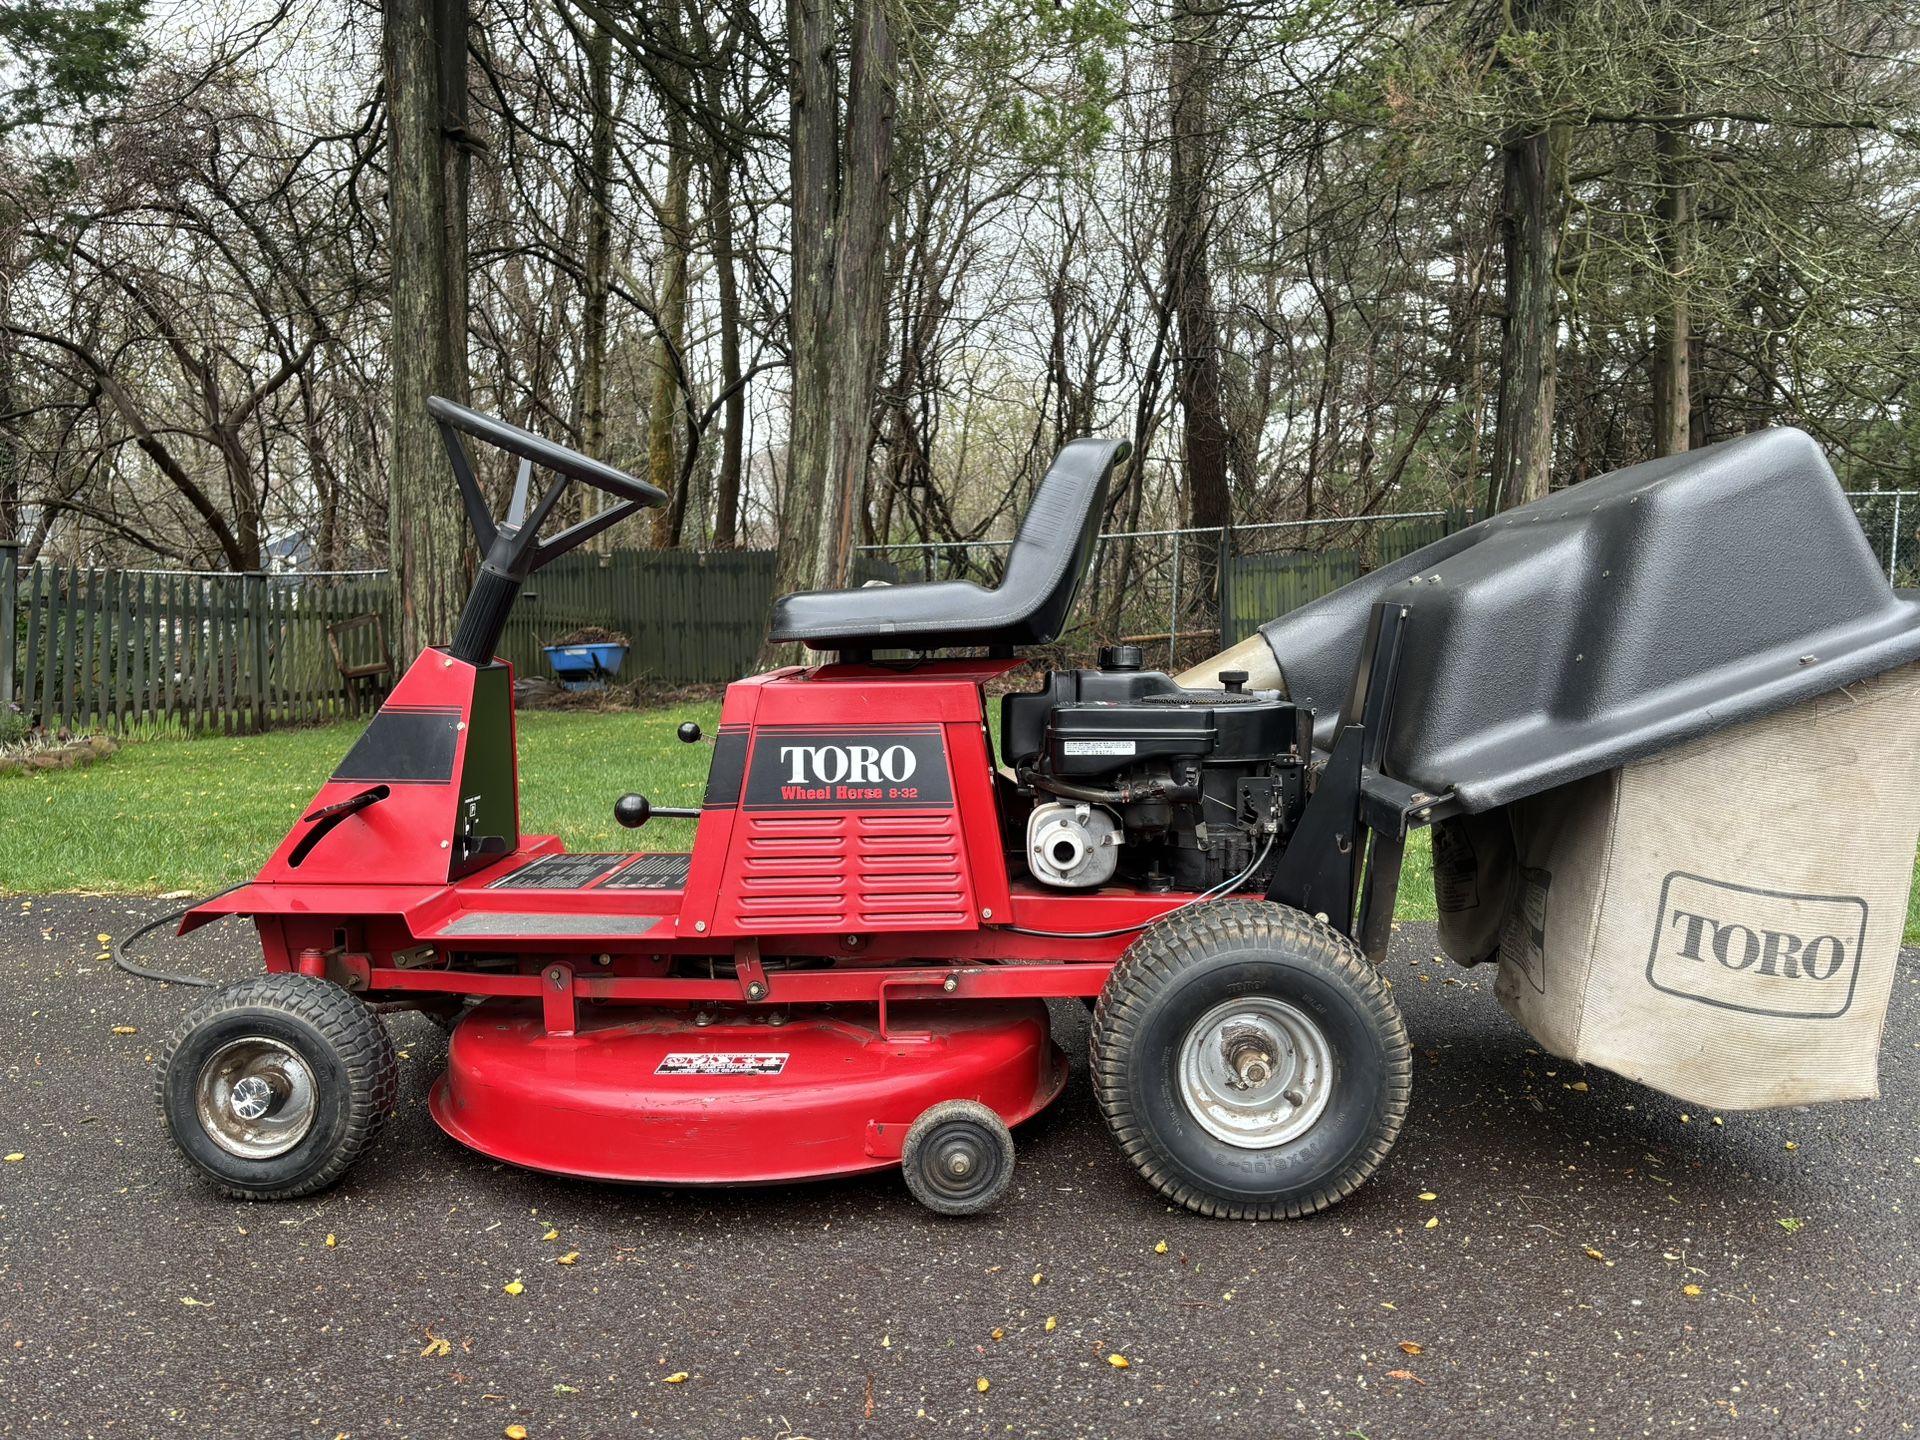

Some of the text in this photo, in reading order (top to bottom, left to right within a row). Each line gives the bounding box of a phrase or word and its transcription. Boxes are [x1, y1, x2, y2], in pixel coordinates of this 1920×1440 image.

[780, 744, 917, 784] TORO
[781, 785, 918, 800] Wheel Horse 8-32
[1672, 910, 1845, 980] TORO
